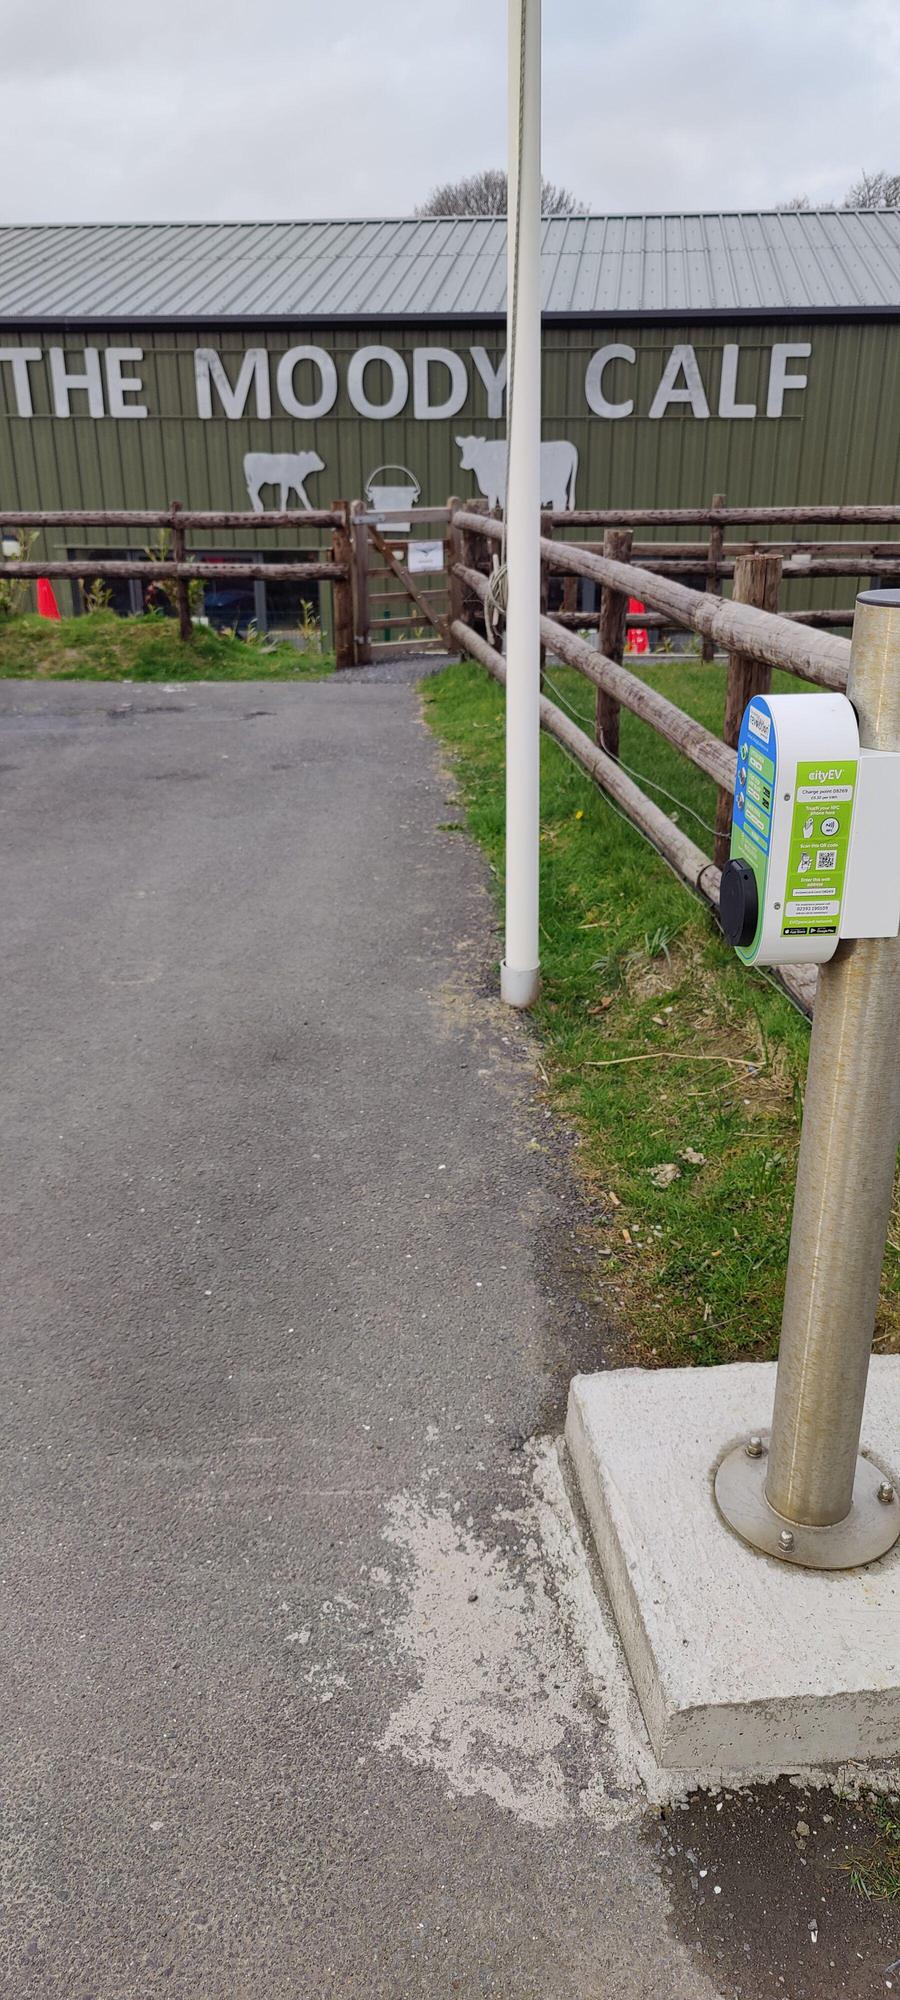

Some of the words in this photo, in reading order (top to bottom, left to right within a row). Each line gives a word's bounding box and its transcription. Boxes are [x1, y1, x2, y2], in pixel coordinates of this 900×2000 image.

[0, 347, 148, 419] THE
[194, 345, 508, 420] MOODY
[585, 343, 812, 419] CALF
[808, 769, 843, 783] cityEV
